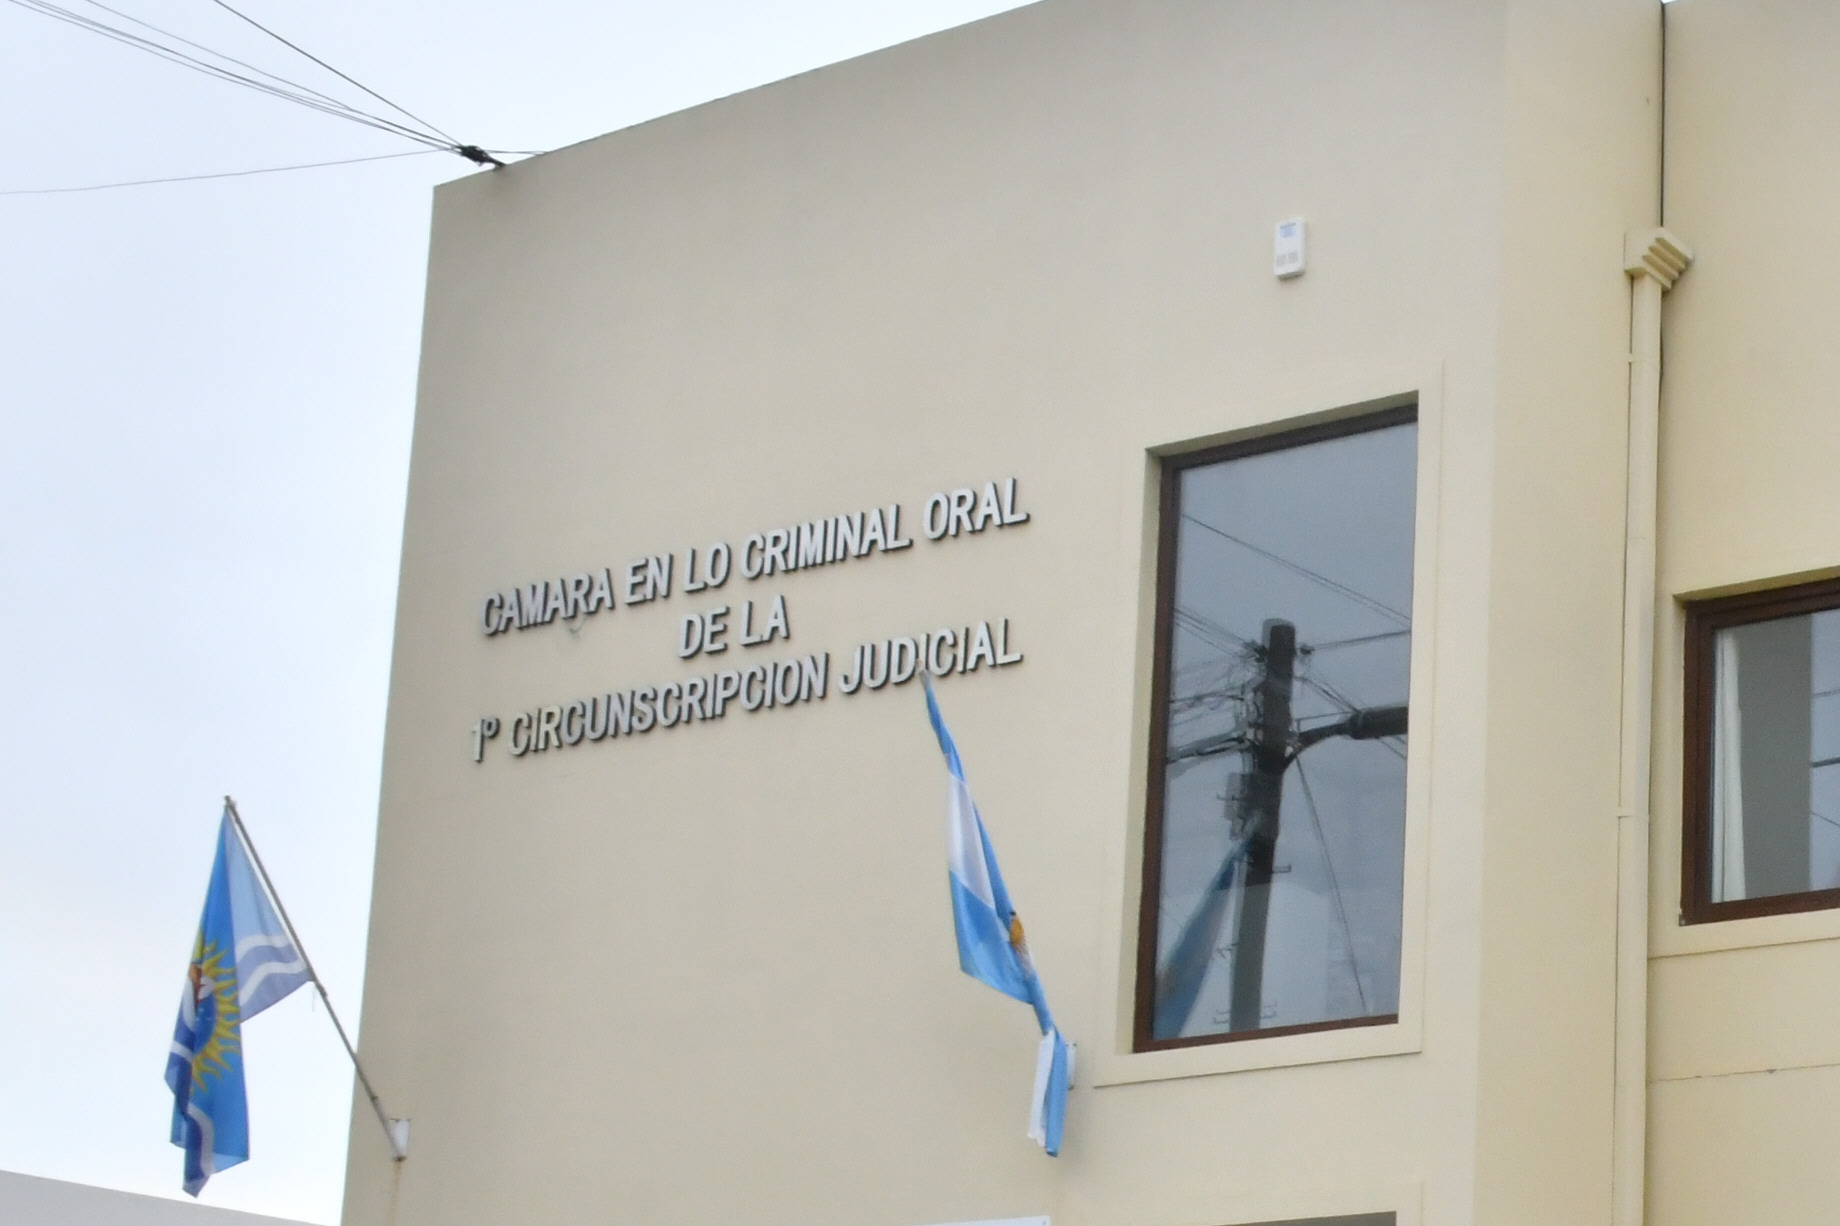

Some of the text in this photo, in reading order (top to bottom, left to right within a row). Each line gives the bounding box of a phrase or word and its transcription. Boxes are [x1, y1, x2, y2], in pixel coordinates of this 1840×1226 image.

[481, 477, 1029, 636] CAMARA EN LO CRIMINAL ORAL
[507, 652, 829, 757] CIRCUNSCRIPCION
[839, 618, 1023, 695] JUDICIAL
[679, 596, 790, 659] DE LA
